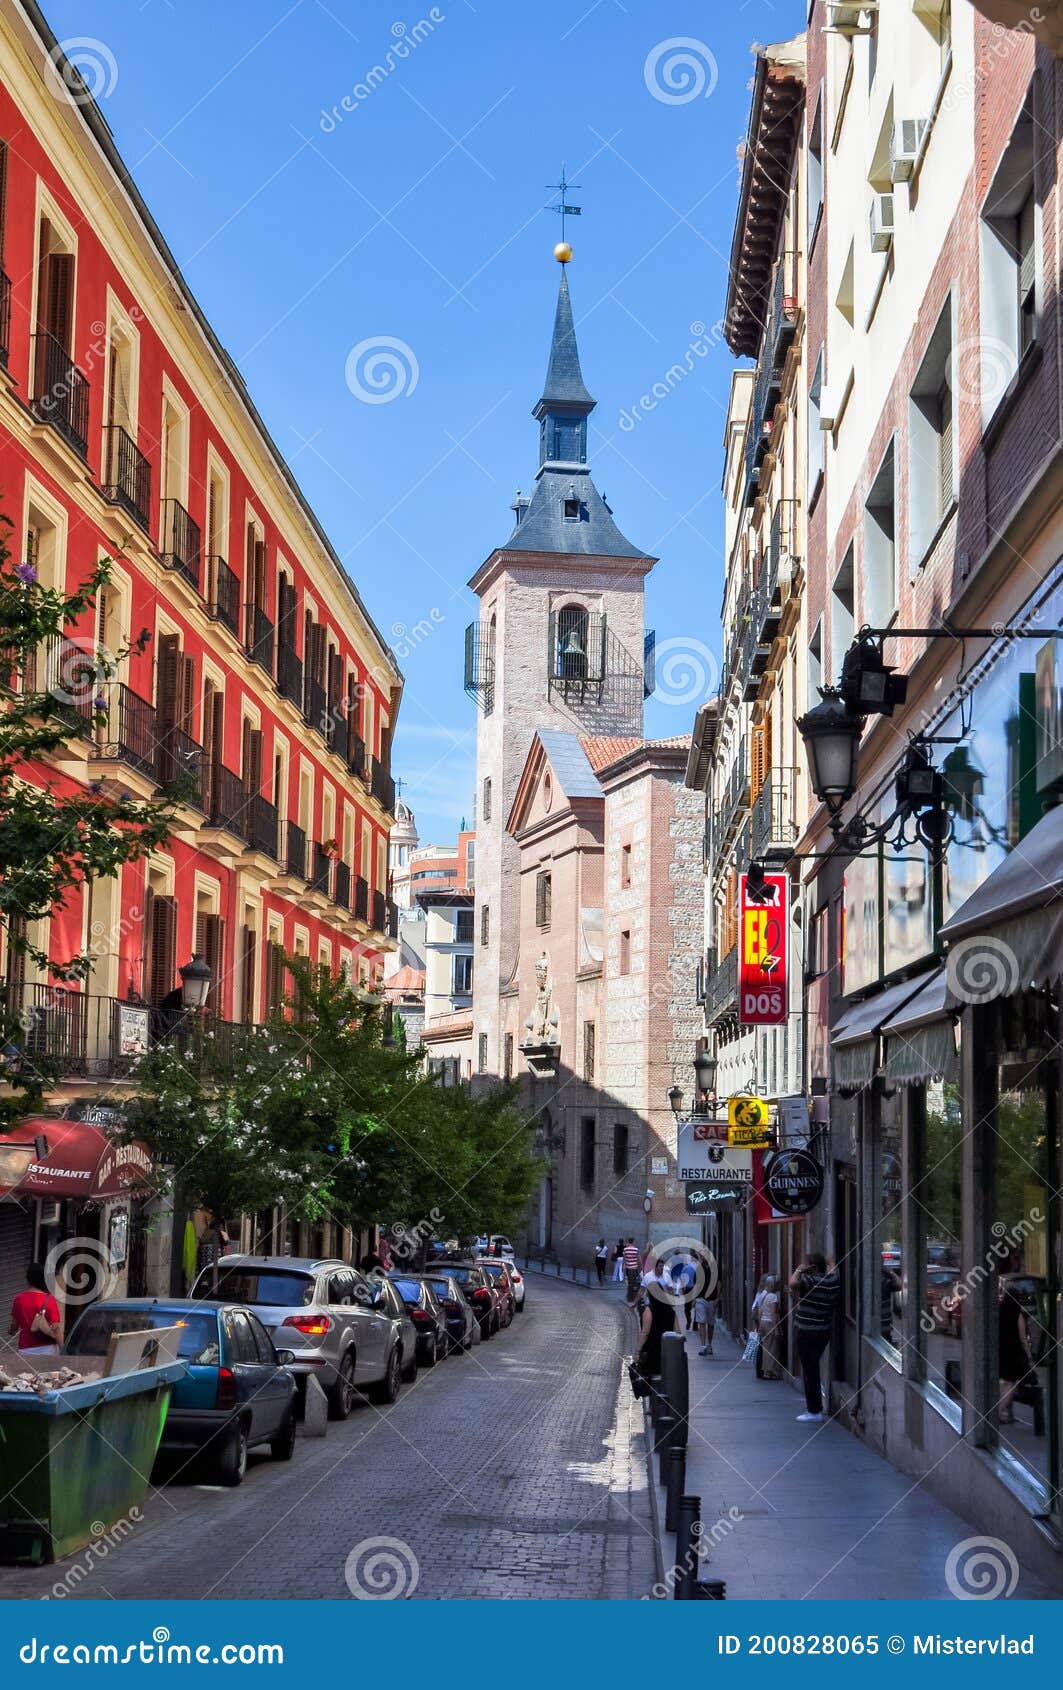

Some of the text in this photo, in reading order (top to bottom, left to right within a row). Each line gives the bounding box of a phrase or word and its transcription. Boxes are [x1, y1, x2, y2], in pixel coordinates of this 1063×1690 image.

[744, 994, 782, 1015] DOS
[695, 1126, 729, 1140] CAF
[27, 1163, 92, 1179] ESTAURANTE
[98, 1157, 112, 1189] BAR
[115, 1144, 154, 1176] RESTAURANTE
[681, 1168, 751, 1180] RESTAURANTE
[769, 1176, 820, 1190] GUINNESS
